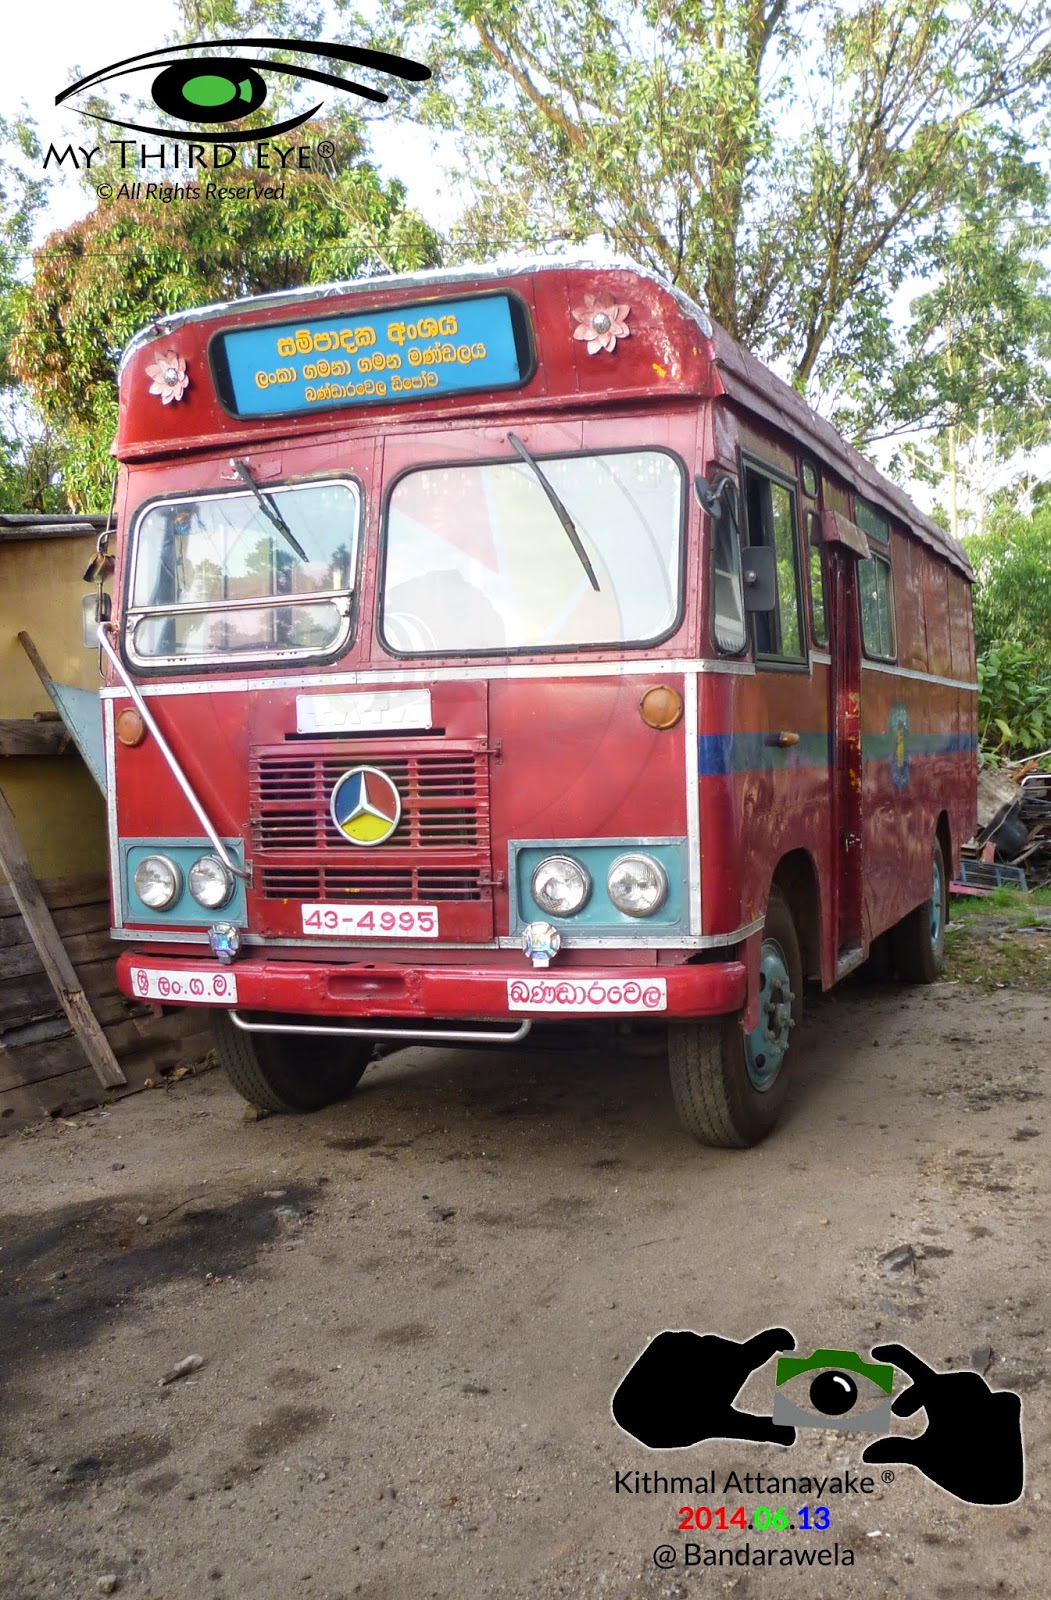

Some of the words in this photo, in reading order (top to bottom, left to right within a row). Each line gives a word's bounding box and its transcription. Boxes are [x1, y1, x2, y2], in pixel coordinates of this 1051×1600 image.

[277, 326, 377, 357] සම්පාදක
[387, 315, 458, 346] අංශය
[255, 367, 297, 389] ලංකා
[303, 359, 351, 379] ගමනා
[357, 352, 402, 373] ගමන
[408, 342, 487, 366] මණ්ඩලය
[305, 379, 387, 402] බණ්ඩාරවෙල
[305, 910, 435, 932] 43-4995
[510, 981, 661, 1008] බණ්ඩාරවෙල
